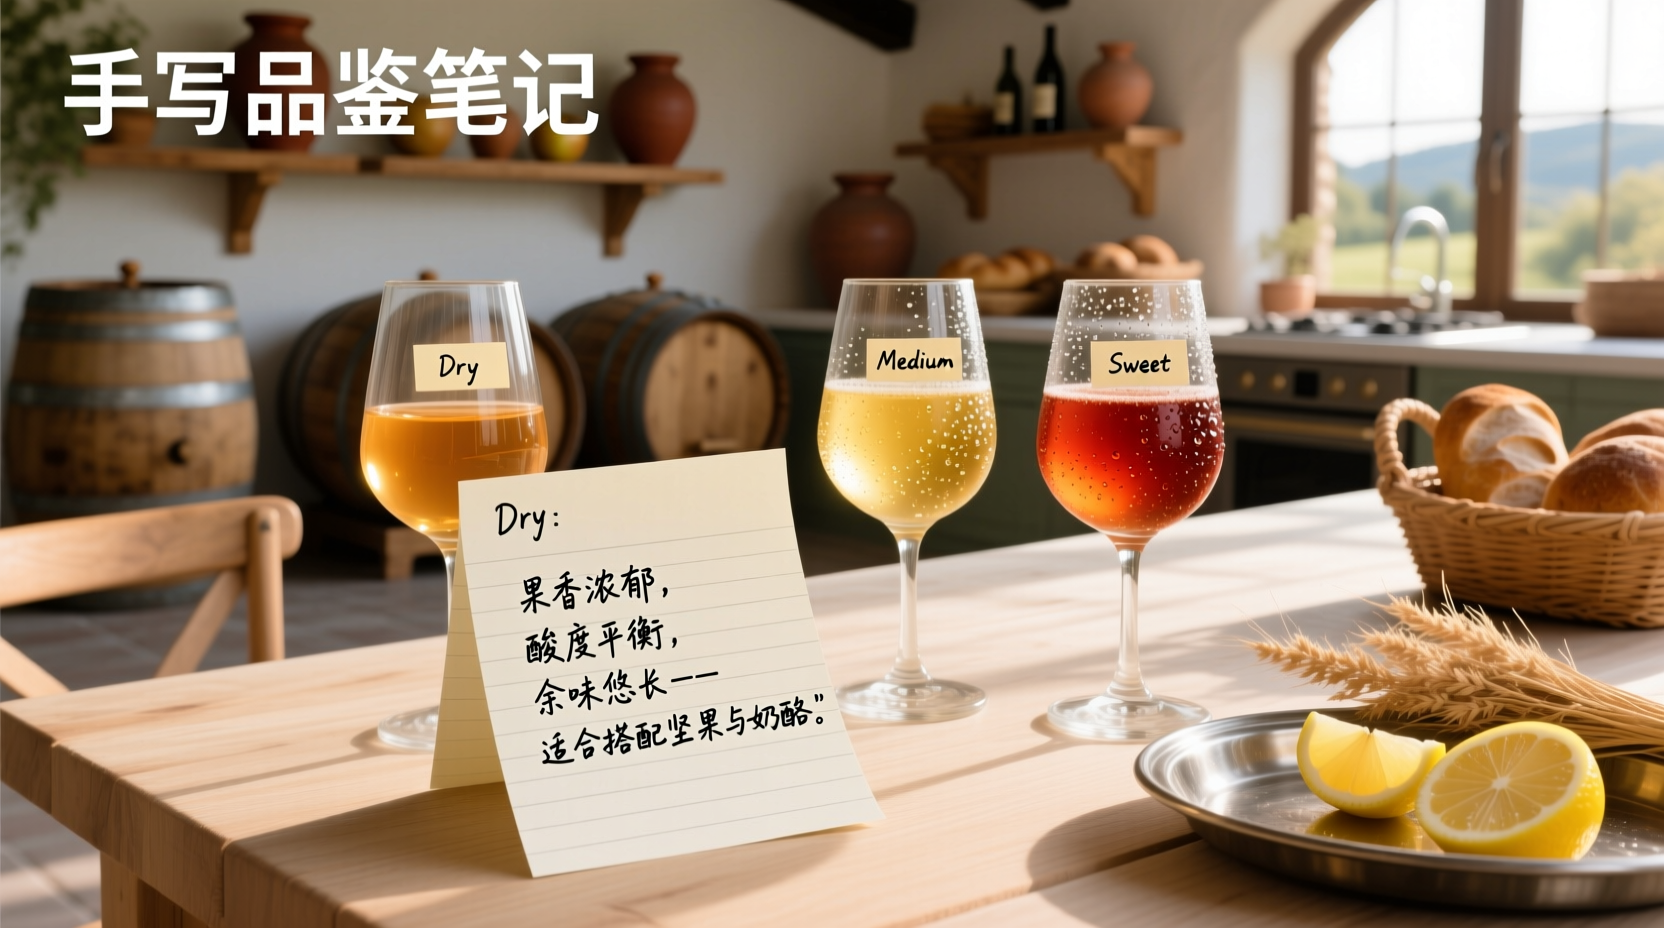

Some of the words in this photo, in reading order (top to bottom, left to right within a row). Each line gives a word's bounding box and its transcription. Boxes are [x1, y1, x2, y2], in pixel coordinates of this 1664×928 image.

[438, 353, 479, 386] Dry
[876, 349, 954, 371] Medium
[1108, 351, 1172, 375] Sweet
[495, 502, 560, 542] Dry:
[520, 564, 669, 614] 果香浓郁，
[524, 615, 678, 664] 酸度平衡，
